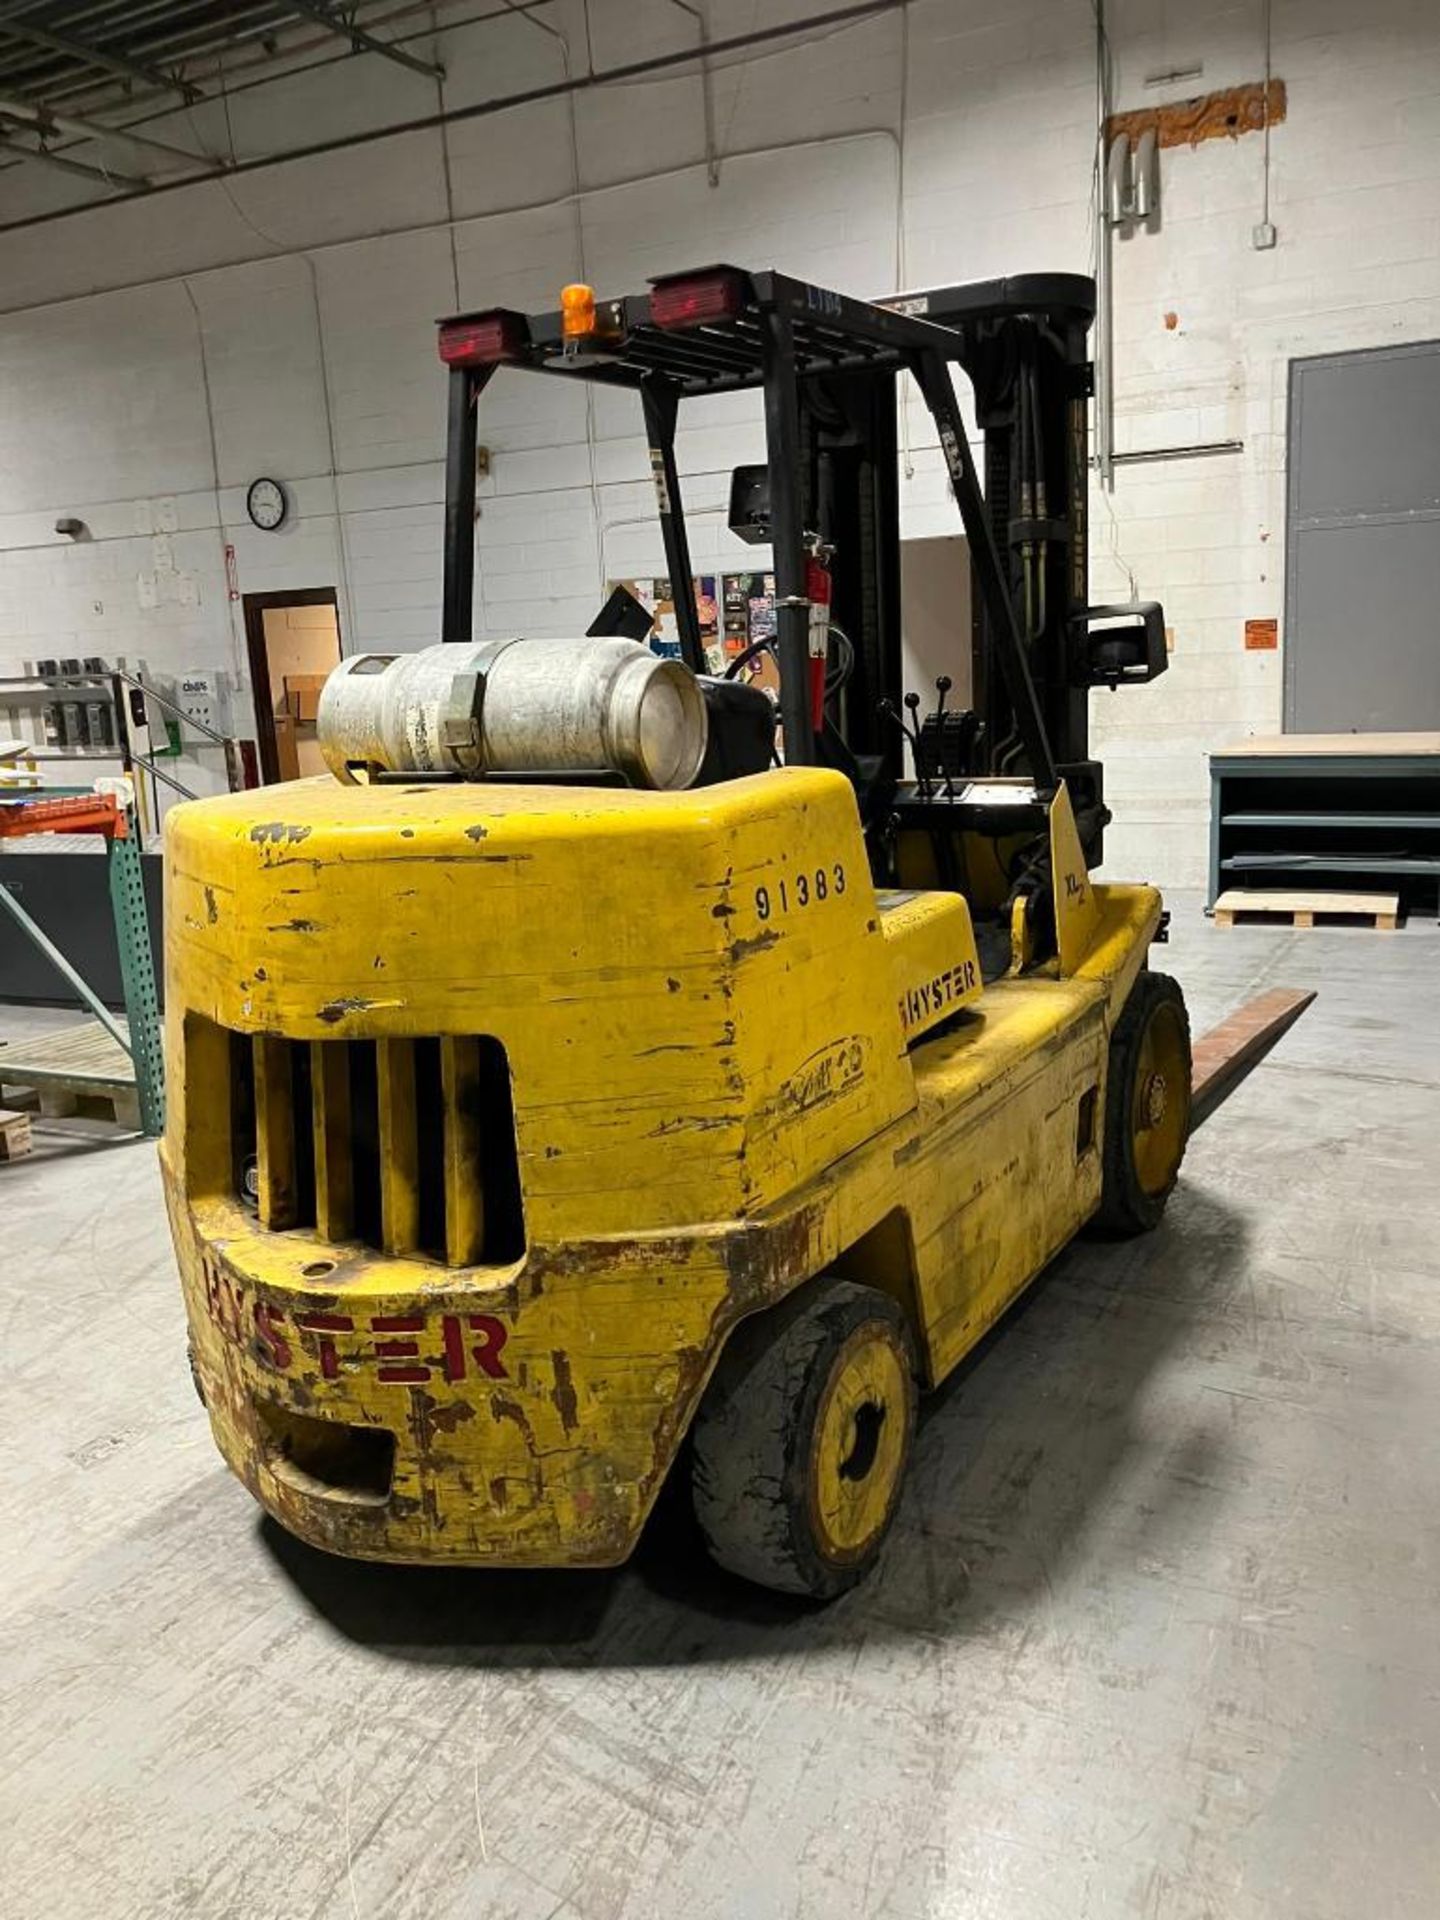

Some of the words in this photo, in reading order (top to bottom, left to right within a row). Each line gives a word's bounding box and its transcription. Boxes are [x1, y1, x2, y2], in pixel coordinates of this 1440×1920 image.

[755, 863, 847, 920] 91383
[906, 960, 975, 1025] HYSTER
[202, 1258, 508, 1381] HYSTER
